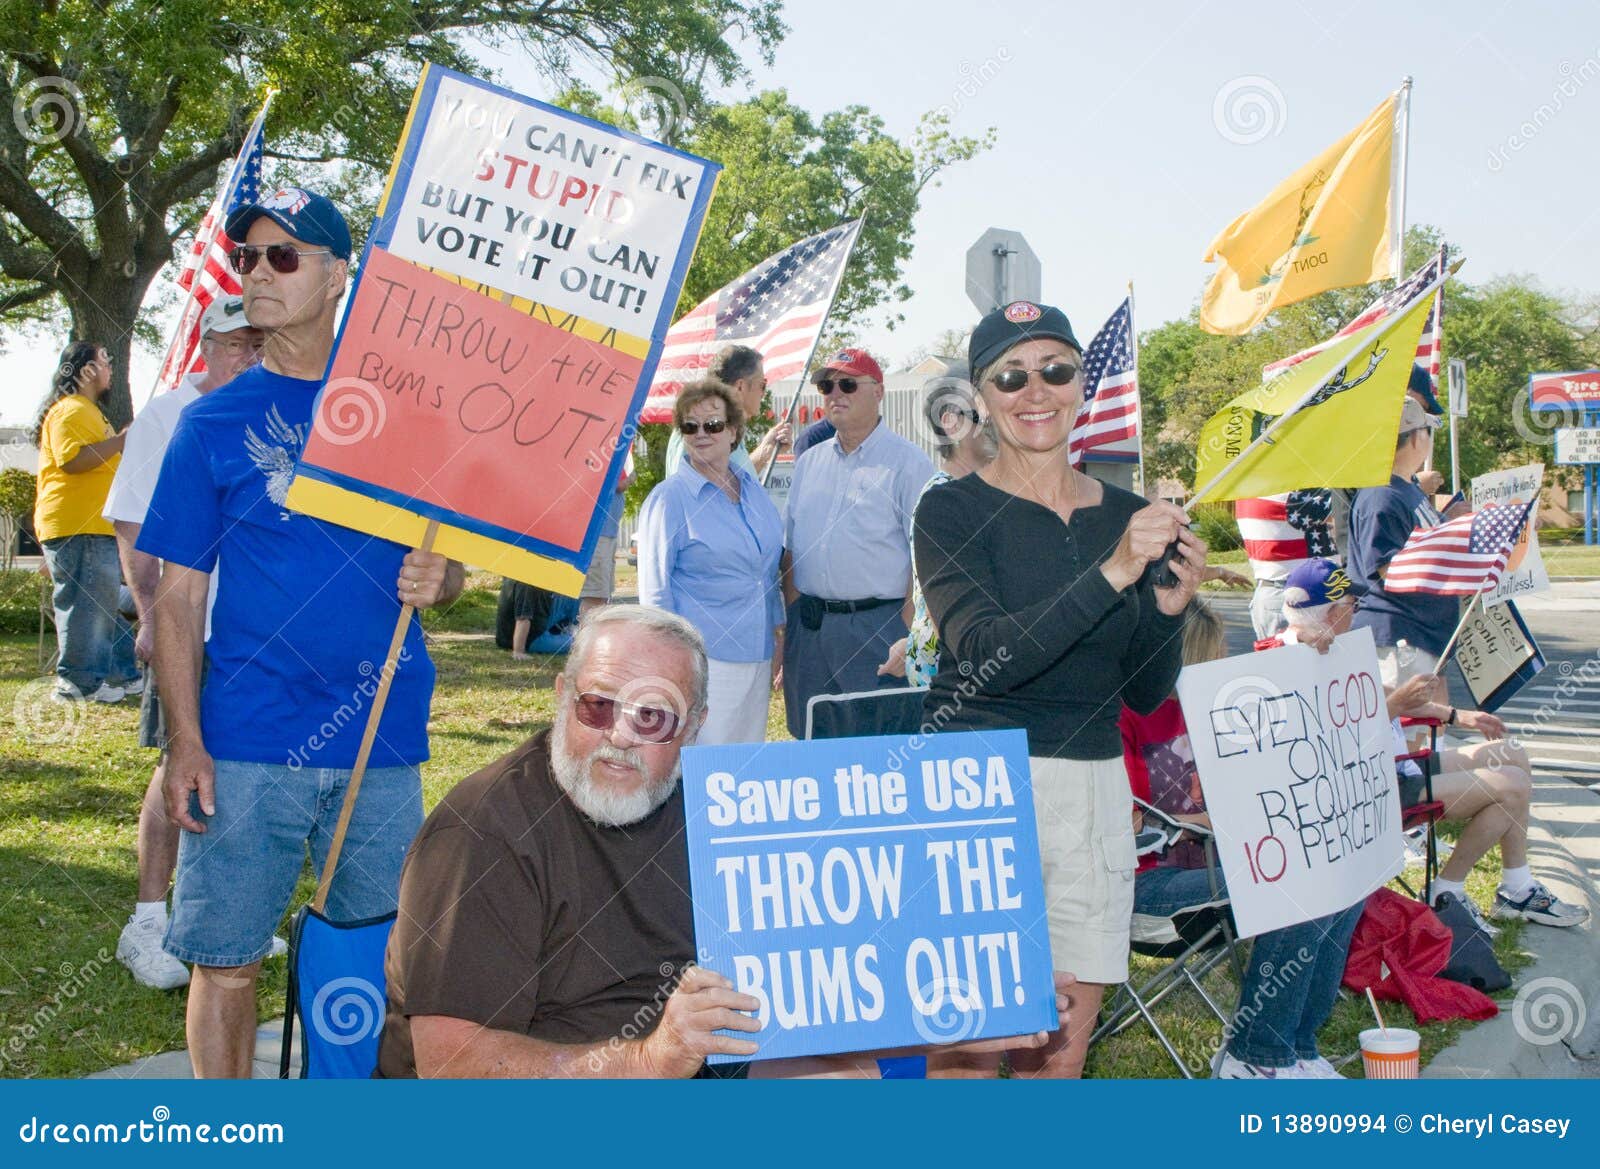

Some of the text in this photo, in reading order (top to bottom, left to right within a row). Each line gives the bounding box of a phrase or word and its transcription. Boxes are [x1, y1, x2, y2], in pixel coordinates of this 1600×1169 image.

[443, 96, 515, 138] YOU
[640, 162, 692, 200] FIX
[473, 148, 634, 223] STUPID
[416, 216, 502, 267] VOTE
[517, 251, 551, 281] IT
[559, 265, 647, 314] OUT!
[421, 181, 660, 279] BUT YOU CAN
[372, 275, 529, 374] THROW
[1474, 619, 1498, 655] only
[1209, 672, 1378, 758] EVEN GOD
[1289, 721, 1361, 782] ONLY
[705, 756, 1015, 827] Save the USA
[1244, 790, 1390, 884] 10 PERCENT
[715, 836, 1022, 933] THROW THE
[733, 932, 1025, 1032] BUMS OUT!
